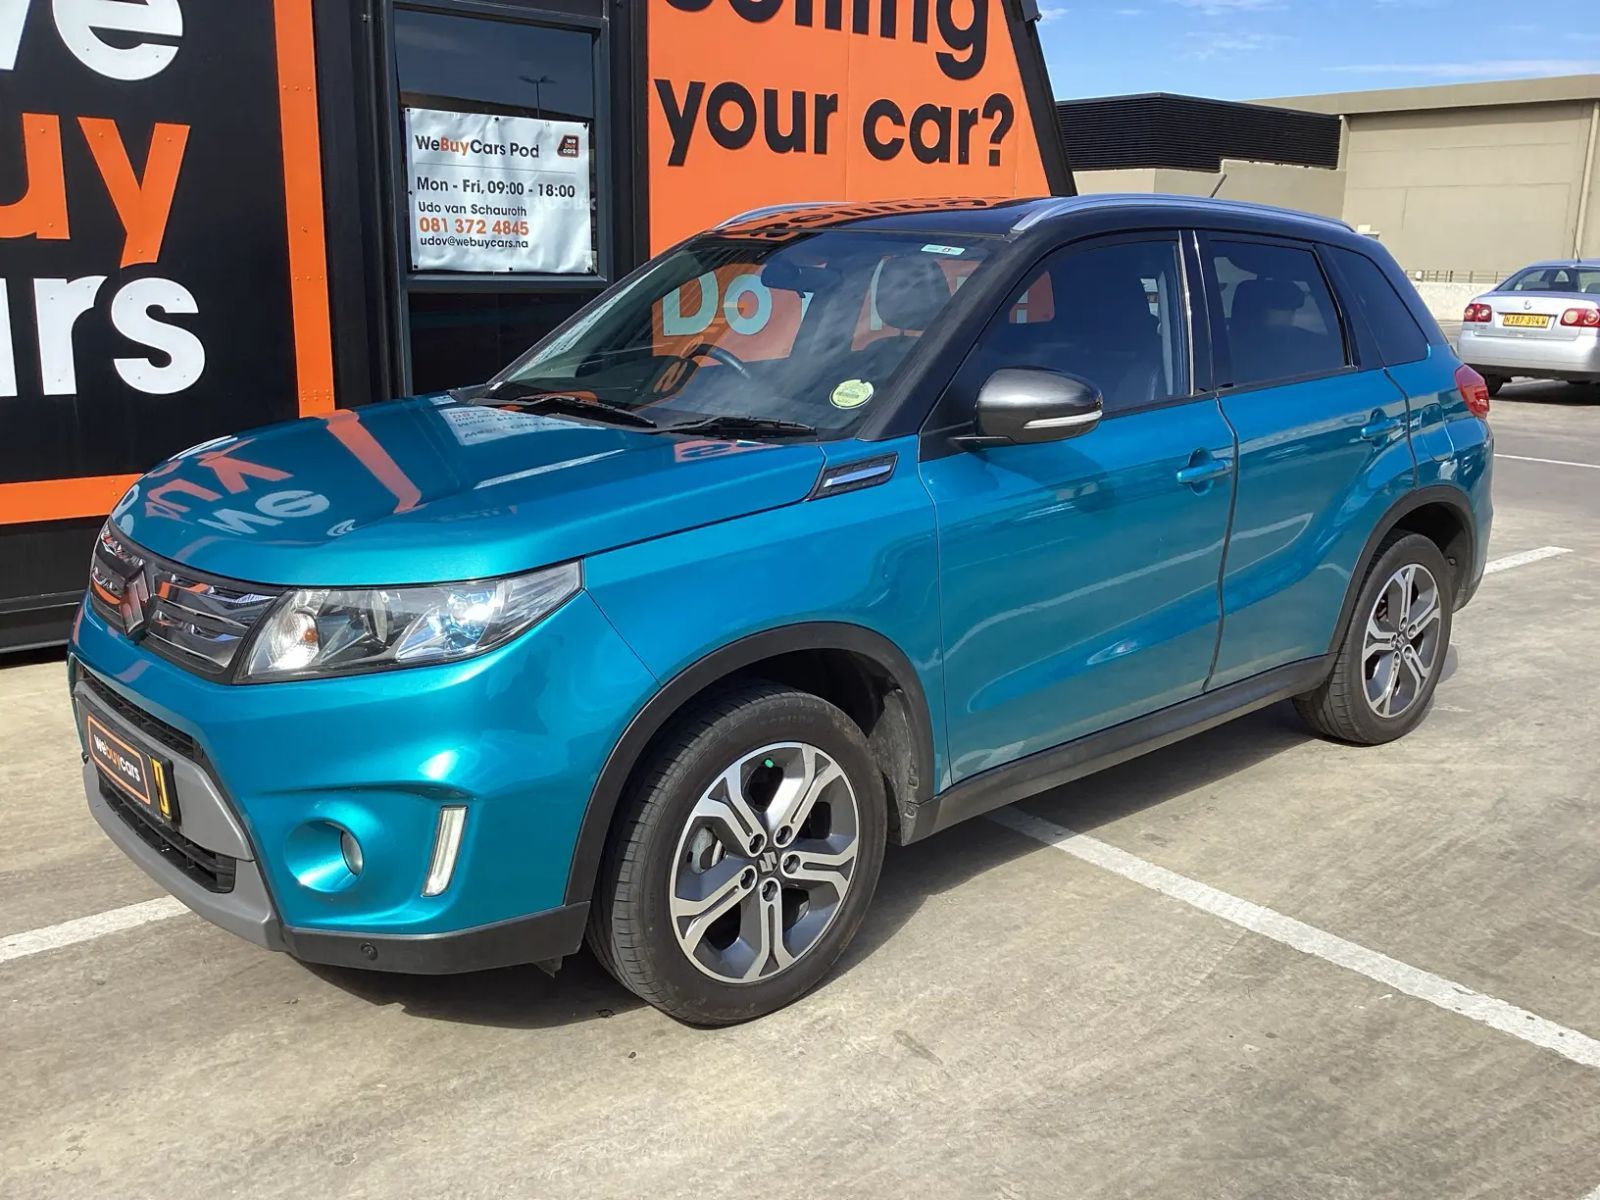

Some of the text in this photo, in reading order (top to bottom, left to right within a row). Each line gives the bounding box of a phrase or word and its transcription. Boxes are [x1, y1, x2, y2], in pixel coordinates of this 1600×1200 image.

[0, 0, 183, 80] e
[654, 79, 1014, 166] your car?
[415, 135, 539, 158] WeBuyCars Pod
[417, 176, 449, 192] Mon
[463, 179, 485, 195] Fri,
[487, 181, 524, 196] 09:00
[538, 184, 576, 198] 18:00
[418, 202, 527, 217] Udo van Schauroth
[419, 217, 529, 236] 081 372 4845
[420, 236, 529, 249] udov@webuycars.na
